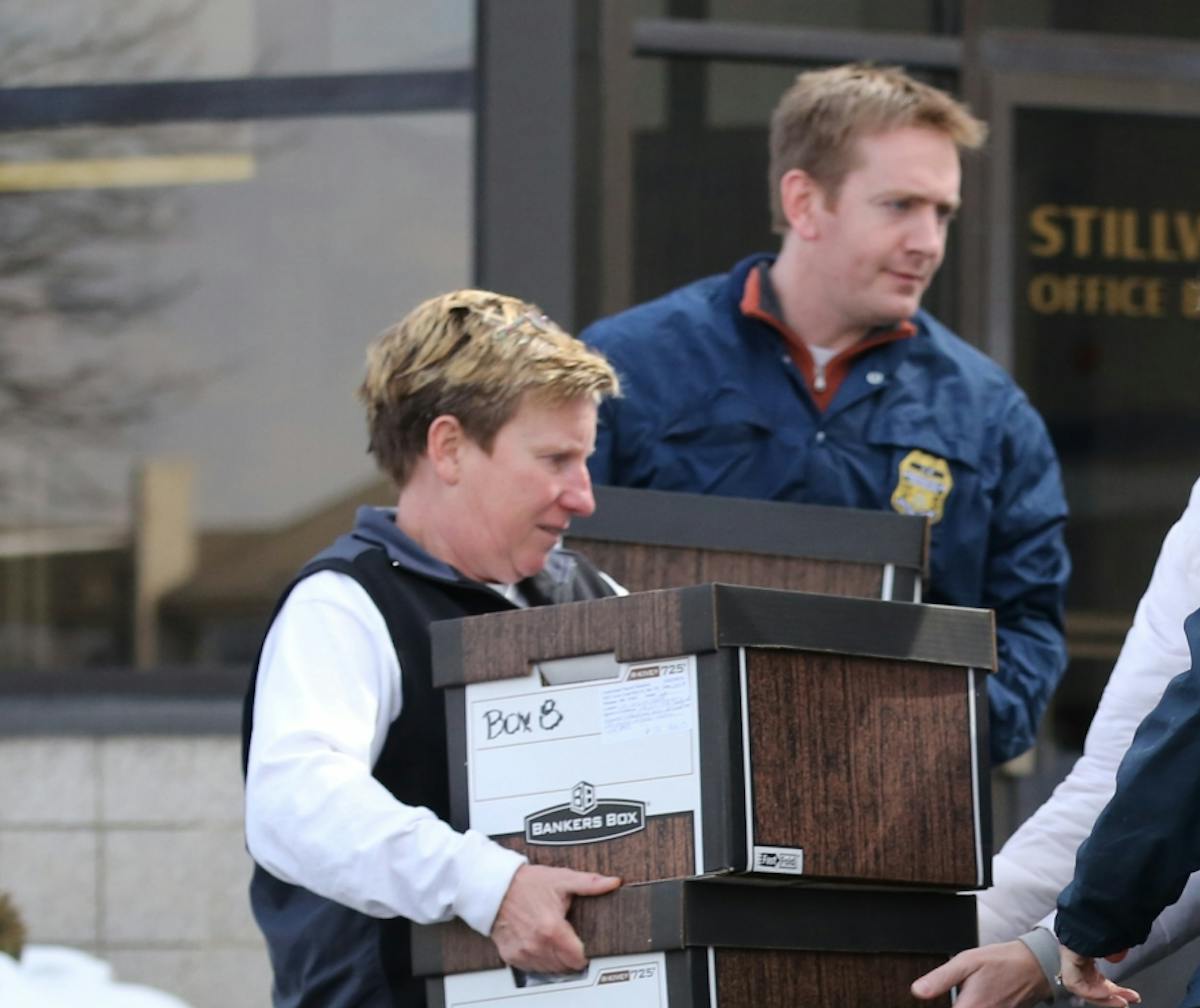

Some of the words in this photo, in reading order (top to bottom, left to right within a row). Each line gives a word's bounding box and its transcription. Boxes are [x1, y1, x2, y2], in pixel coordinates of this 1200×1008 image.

[1029, 272, 1163, 317] OFFICE
[482, 708, 532, 740] Box
[538, 698, 564, 731] 8
[531, 815, 603, 836] BANKERS
[605, 811, 639, 827] BOX
